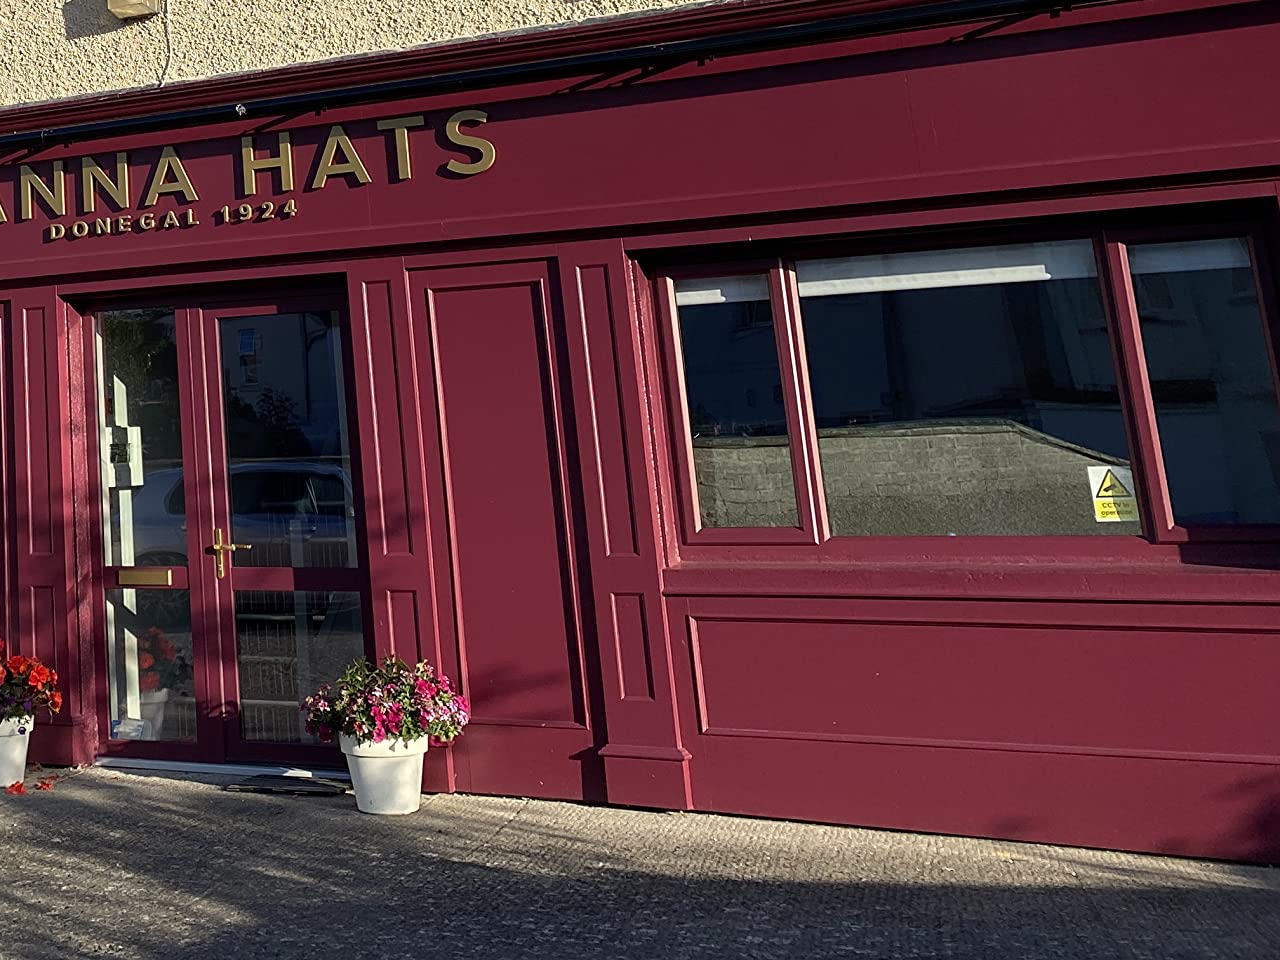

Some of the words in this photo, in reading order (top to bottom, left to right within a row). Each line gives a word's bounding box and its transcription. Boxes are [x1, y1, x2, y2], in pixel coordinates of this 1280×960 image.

[241, 109, 497, 196] HATS
[50, 208, 200, 240] DONEGAL
[219, 199, 297, 224] 1924
